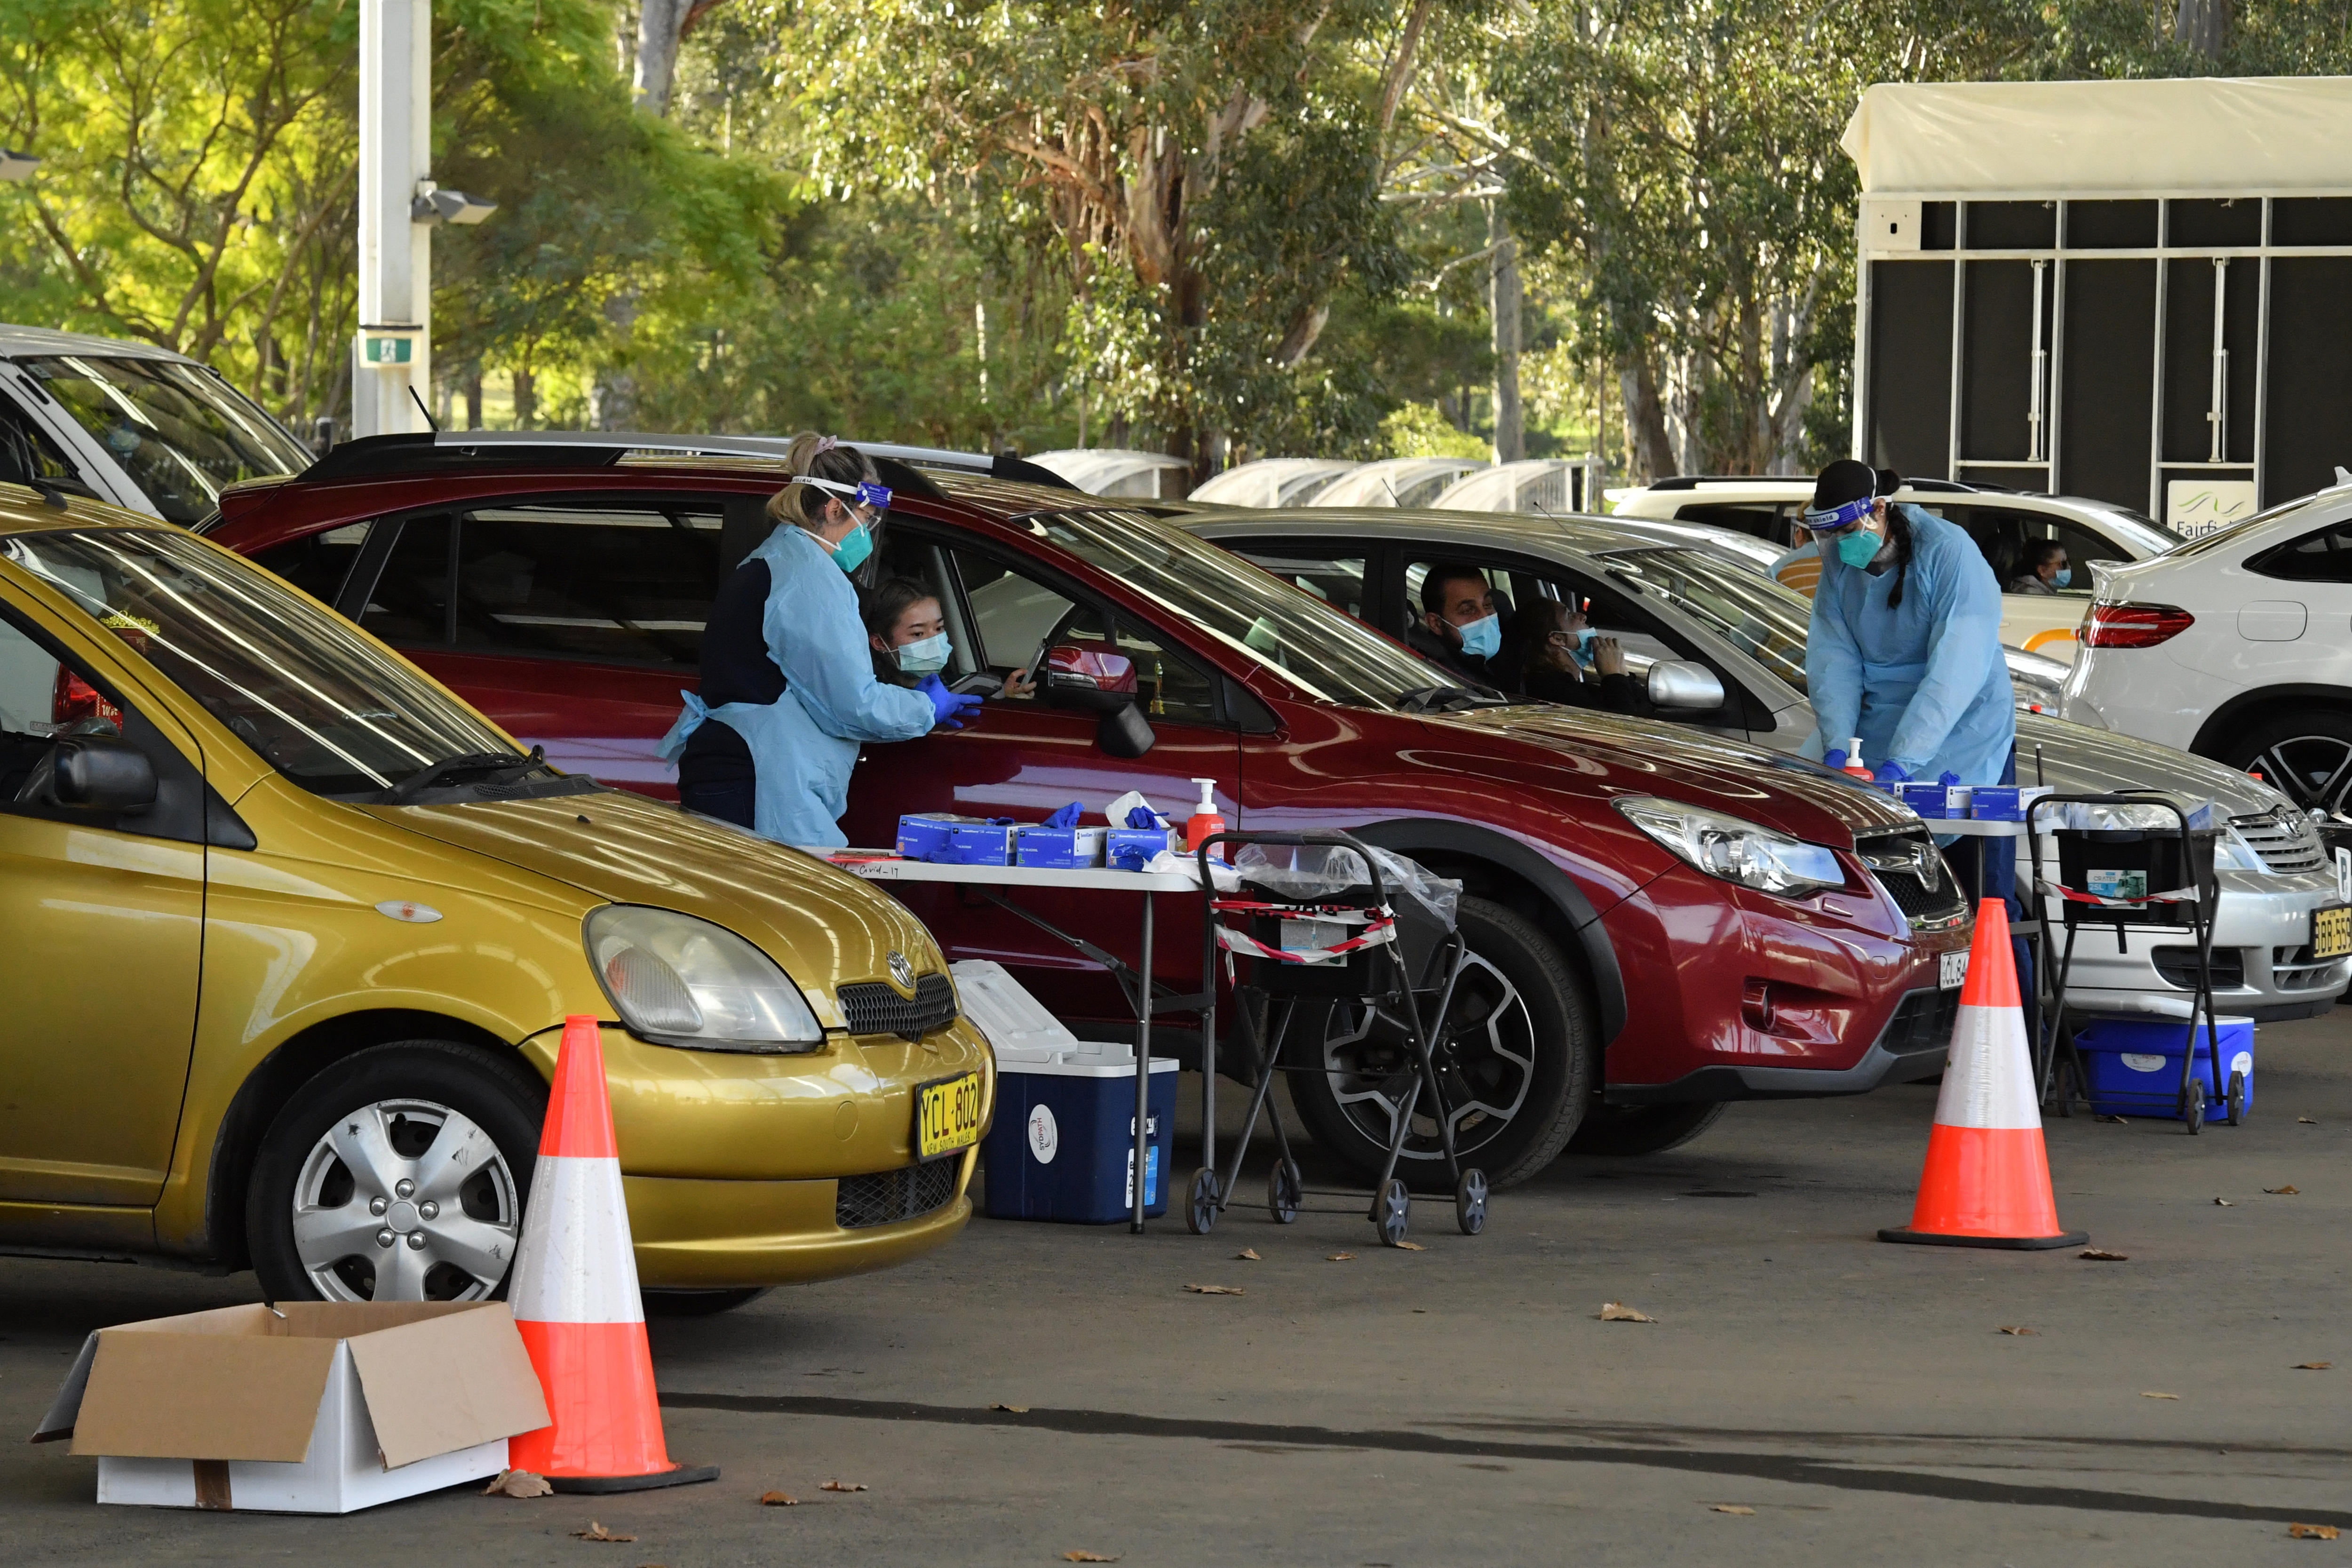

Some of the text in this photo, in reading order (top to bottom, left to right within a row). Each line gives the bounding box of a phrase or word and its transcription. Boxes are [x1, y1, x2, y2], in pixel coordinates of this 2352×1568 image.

[1814, 514, 1833, 523] shield
[898, 842, 905, 852] S
[1018, 853, 1025, 864] L
[2340, 856, 2347, 892] P
[926, 1131, 970, 1156] NEW SOUTH WALES
